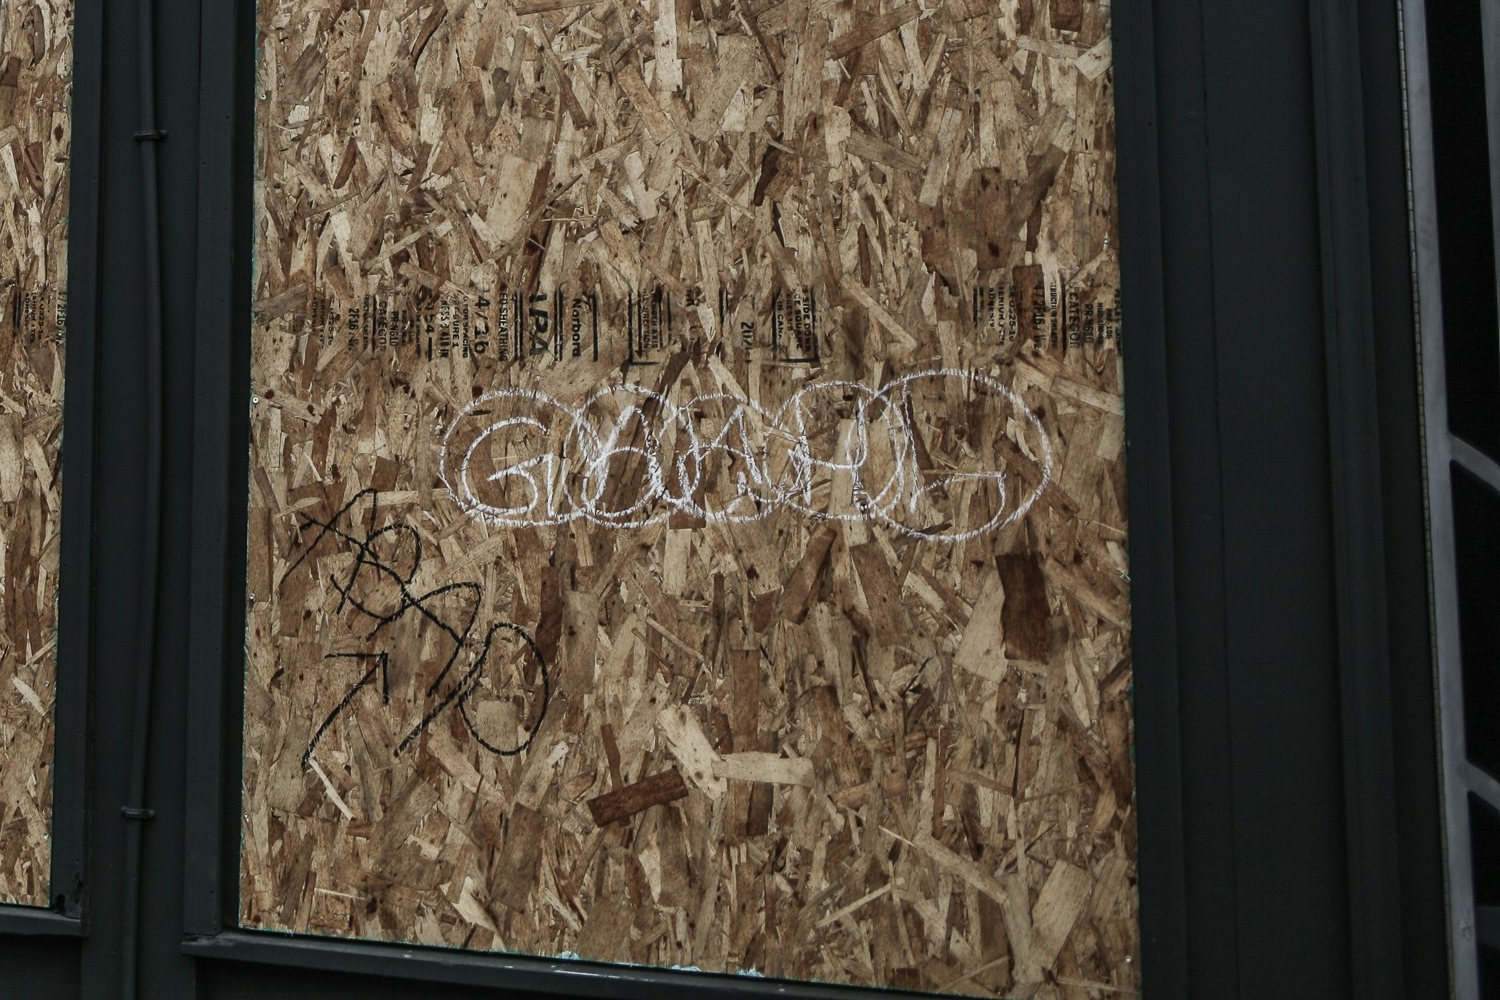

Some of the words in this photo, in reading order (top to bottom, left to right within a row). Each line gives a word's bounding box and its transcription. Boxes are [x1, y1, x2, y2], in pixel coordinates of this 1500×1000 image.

[348, 308, 359, 329] 2F16
[425, 303, 434, 333] 454
[803, 297, 811, 320] SIDE
[1033, 301, 1045, 325] 2F16
[1083, 304, 1094, 342] PR-N610
[389, 312, 399, 346] PR-N610
[498, 308, 508, 361] SHEATHING
[572, 299, 581, 357] Norbord
[795, 310, 803, 350] SQUARE
[440, 349, 449, 358] IN
